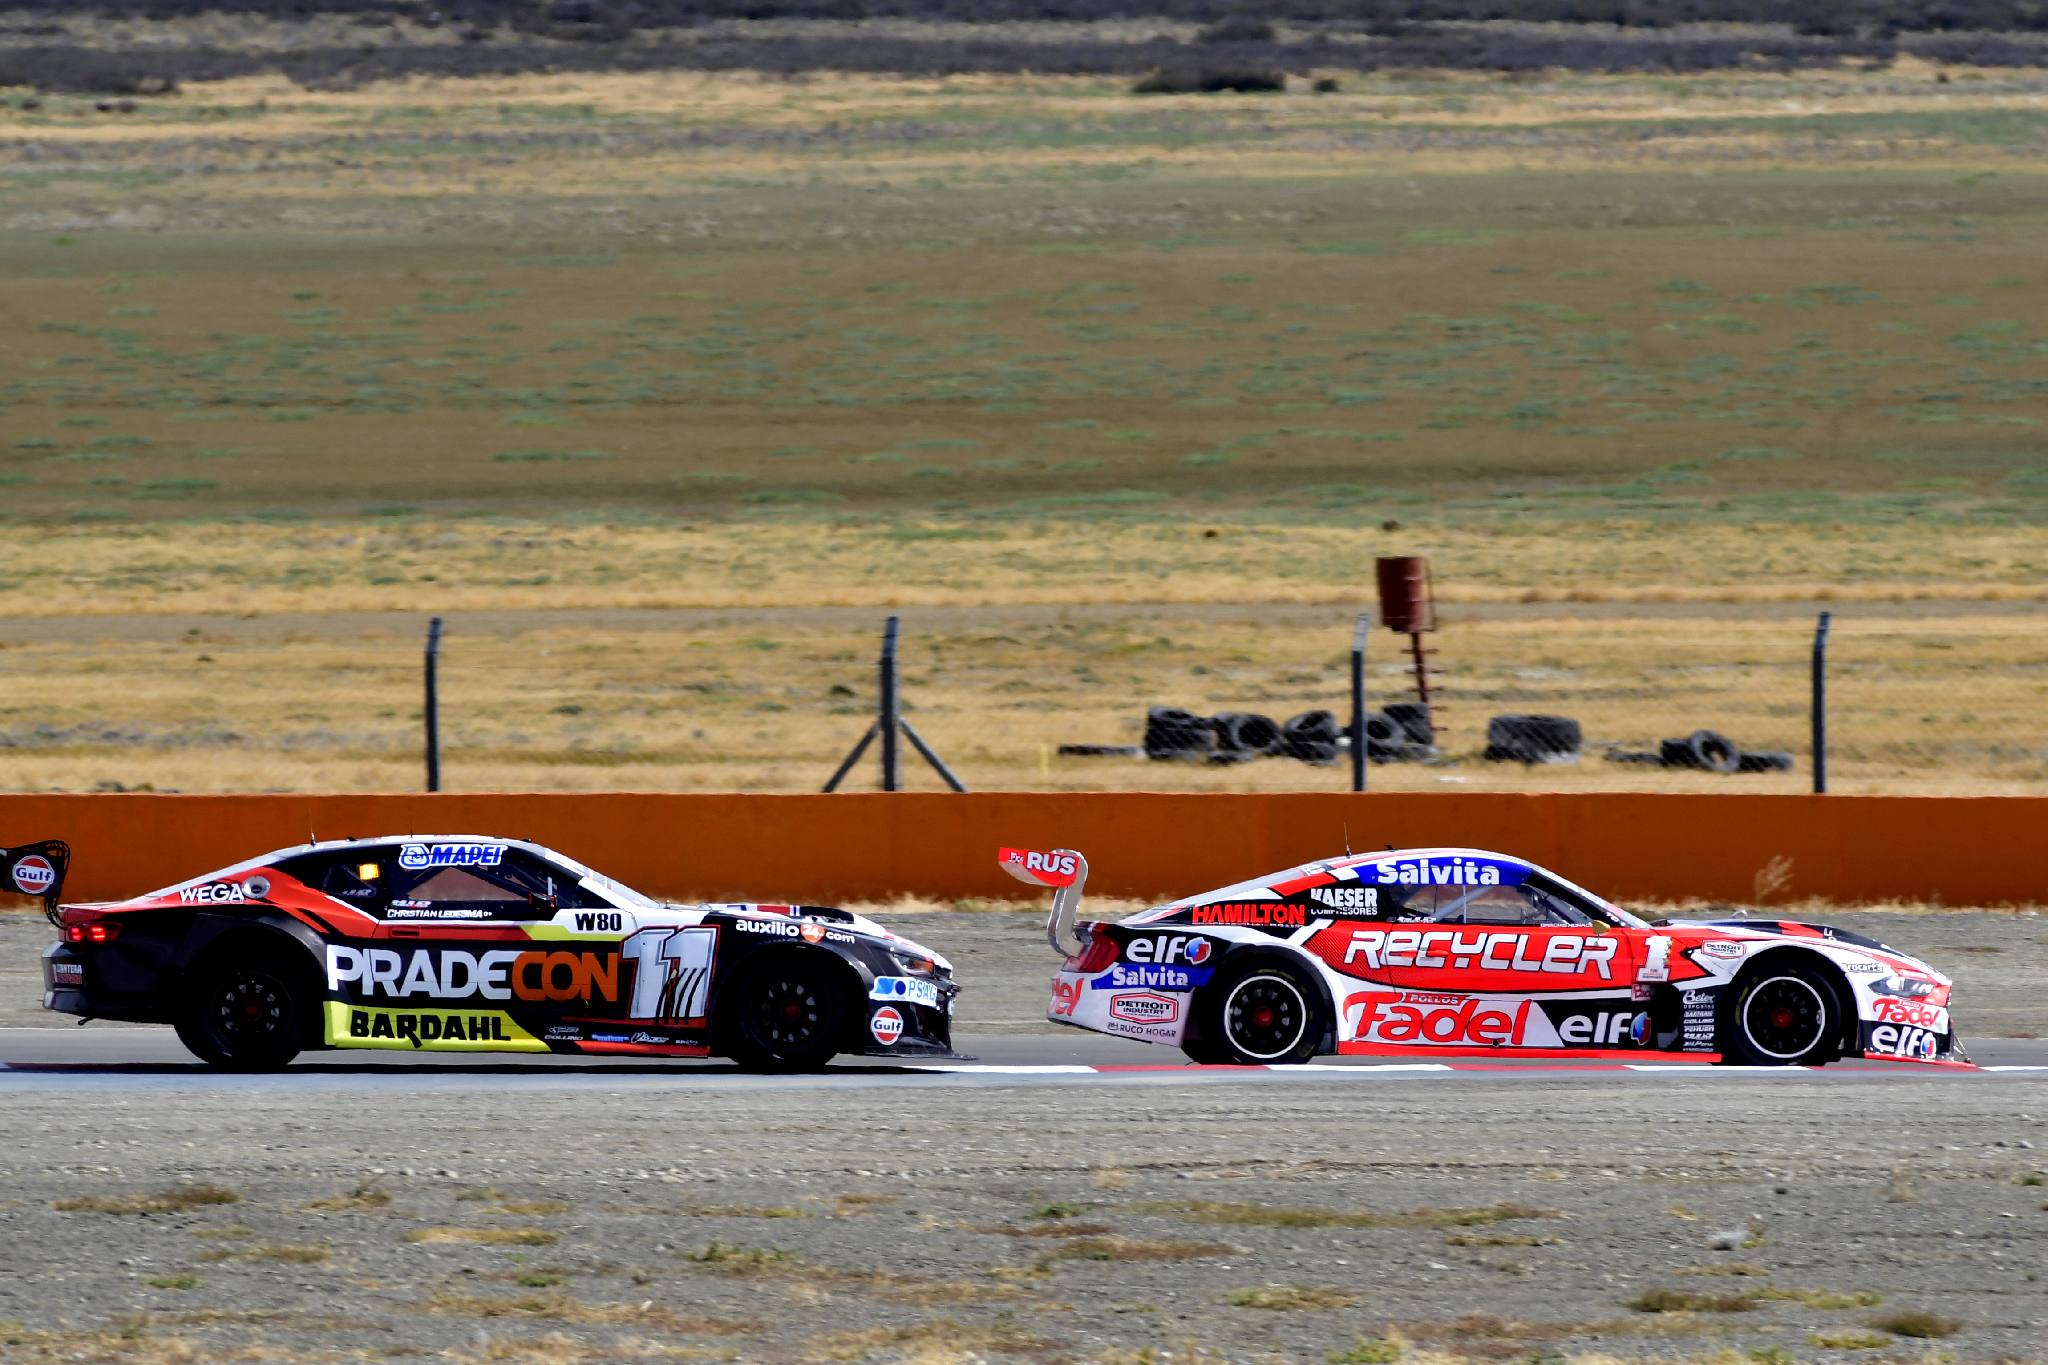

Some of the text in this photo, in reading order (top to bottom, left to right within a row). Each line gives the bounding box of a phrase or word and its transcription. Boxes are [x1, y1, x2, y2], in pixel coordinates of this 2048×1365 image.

[430, 845, 505, 865] MAPEI
[1027, 851, 1076, 876] RUS
[15, 866, 51, 882] Gulf
[1376, 857, 1500, 886] Salvita
[179, 883, 244, 902] WEGA
[387, 908, 437, 918] CHRISTIAN
[575, 912, 622, 932] W80
[1192, 904, 1305, 925] HAMILTON
[736, 919, 799, 937] auxilio
[825, 931, 855, 944] com
[1126, 935, 1186, 964] elf
[1343, 929, 1619, 980] RECYCLER
[1635, 934, 1672, 982] 1
[326, 944, 619, 1002] PRADECON
[622, 926, 717, 1020] 11
[1112, 966, 1189, 987] Salvita
[908, 979, 937, 1001] PSAG
[1409, 993, 1460, 1005] POLLOS
[1117, 1000, 1171, 1010] DETROIT
[1123, 1007, 1165, 1015] INDUSTRY
[1872, 997, 1941, 1028] Fadel
[350, 1009, 511, 1048] BARDAHL
[873, 1018, 902, 1032] Gulf
[1342, 990, 1533, 1046] Fadel
[1558, 1011, 1632, 1044] elf
[1119, 1025, 1144, 1034] RUCO
[1146, 1028, 1177, 1038] HOGAR
[1871, 1025, 1924, 1056] elf
